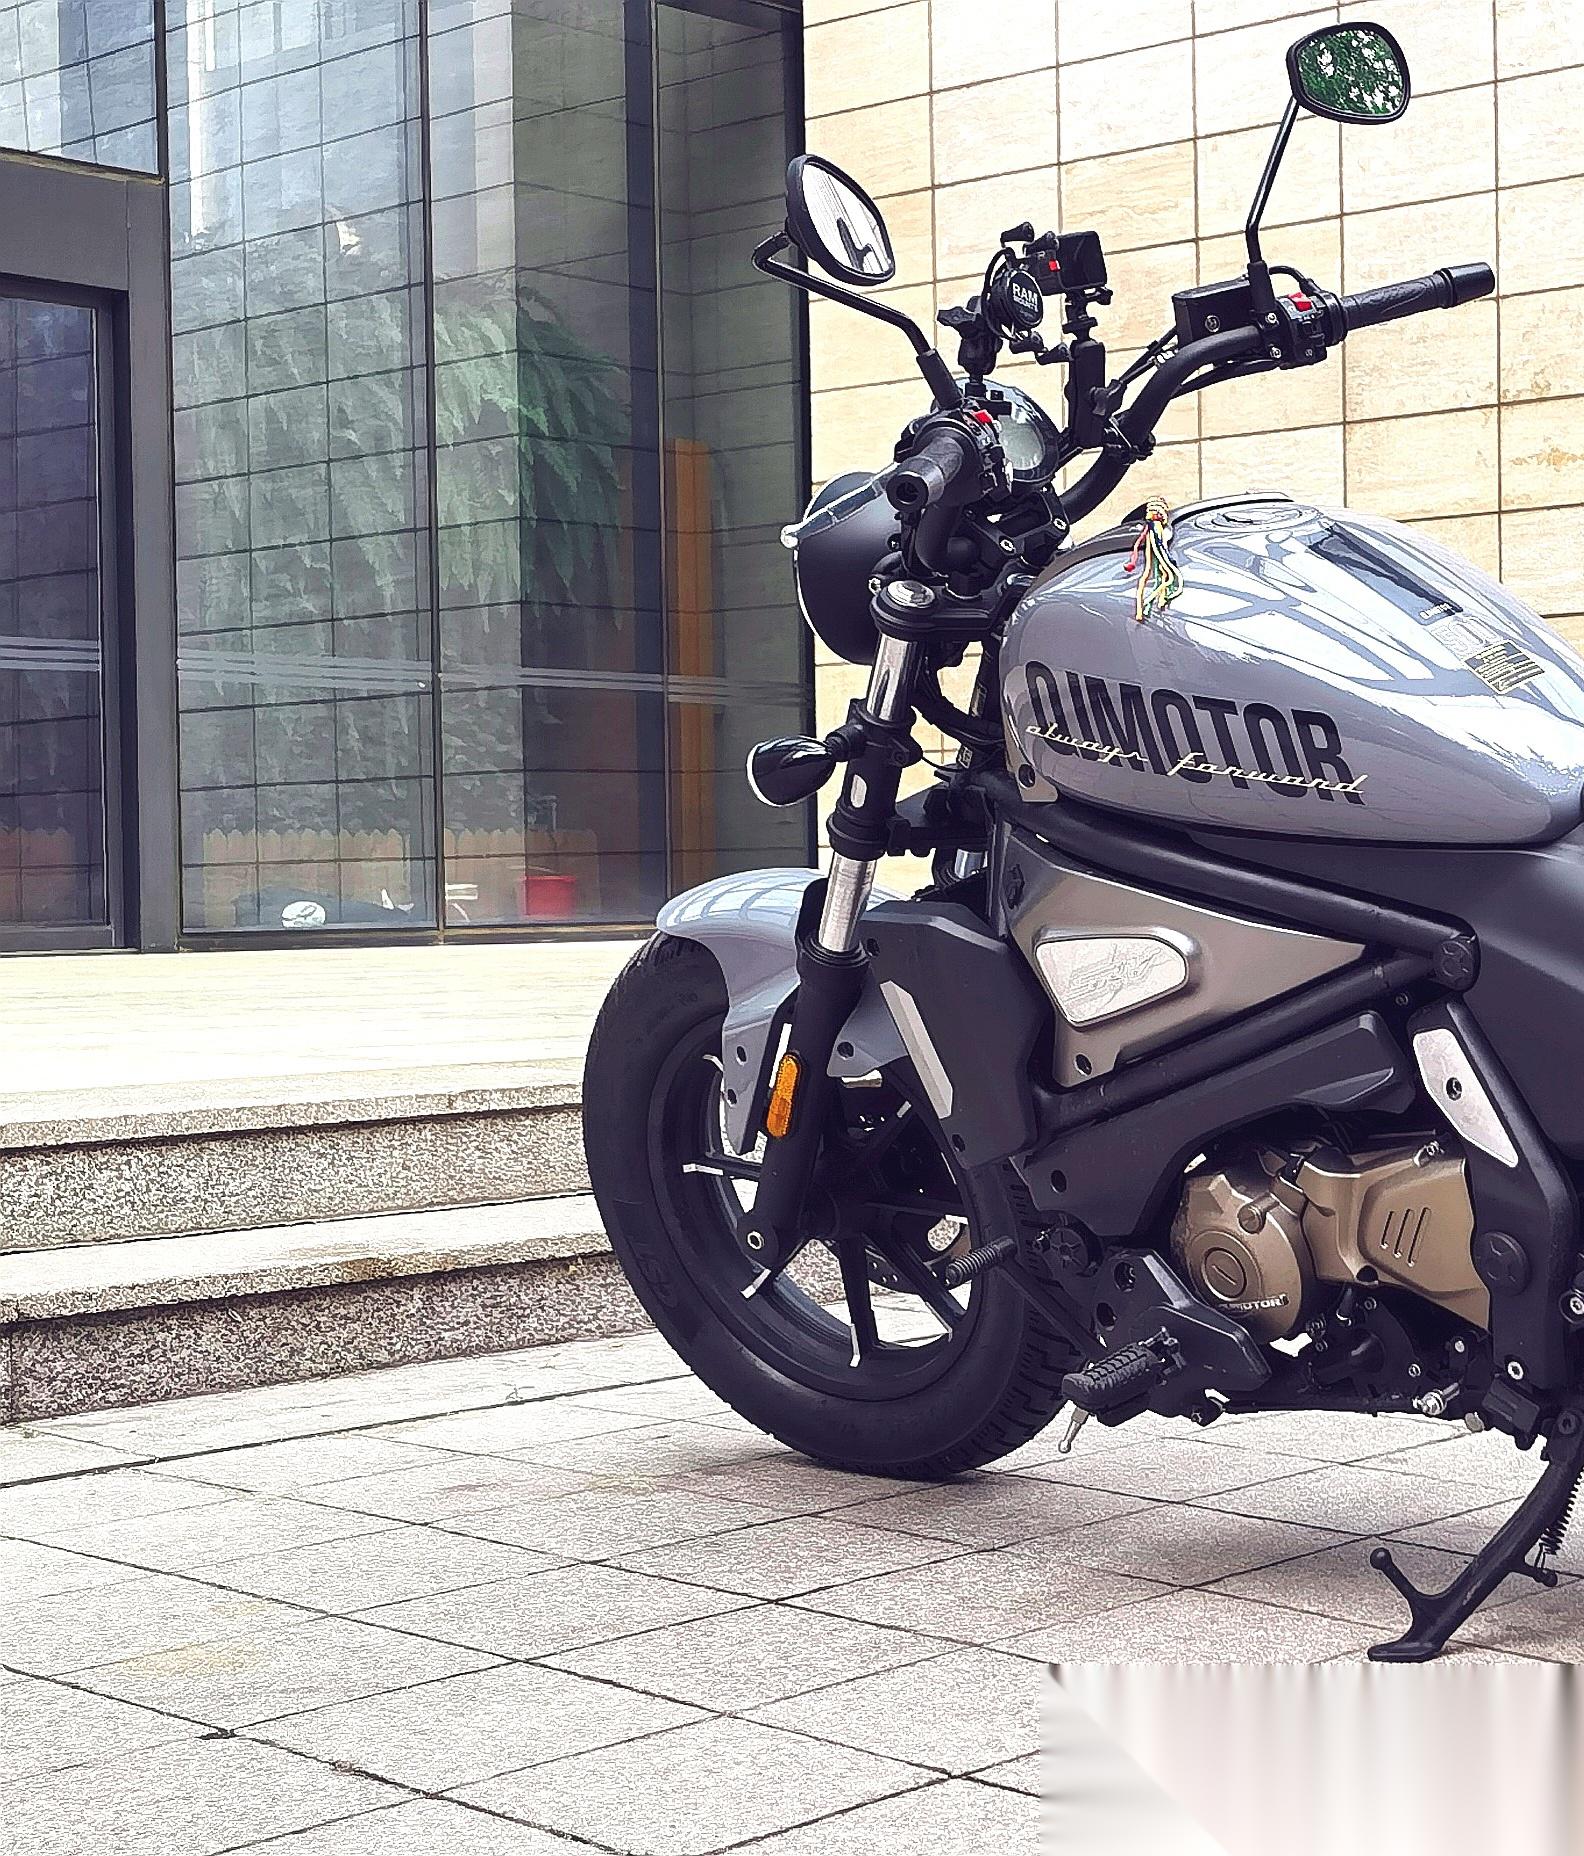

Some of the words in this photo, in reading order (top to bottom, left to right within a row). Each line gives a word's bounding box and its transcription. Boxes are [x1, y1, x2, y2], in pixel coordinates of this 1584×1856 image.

[1012, 283, 1038, 305] RAM
[1025, 660, 1367, 806] QJMOTOR
[1025, 722, 1149, 763] always
[1166, 752, 1369, 795] forward
